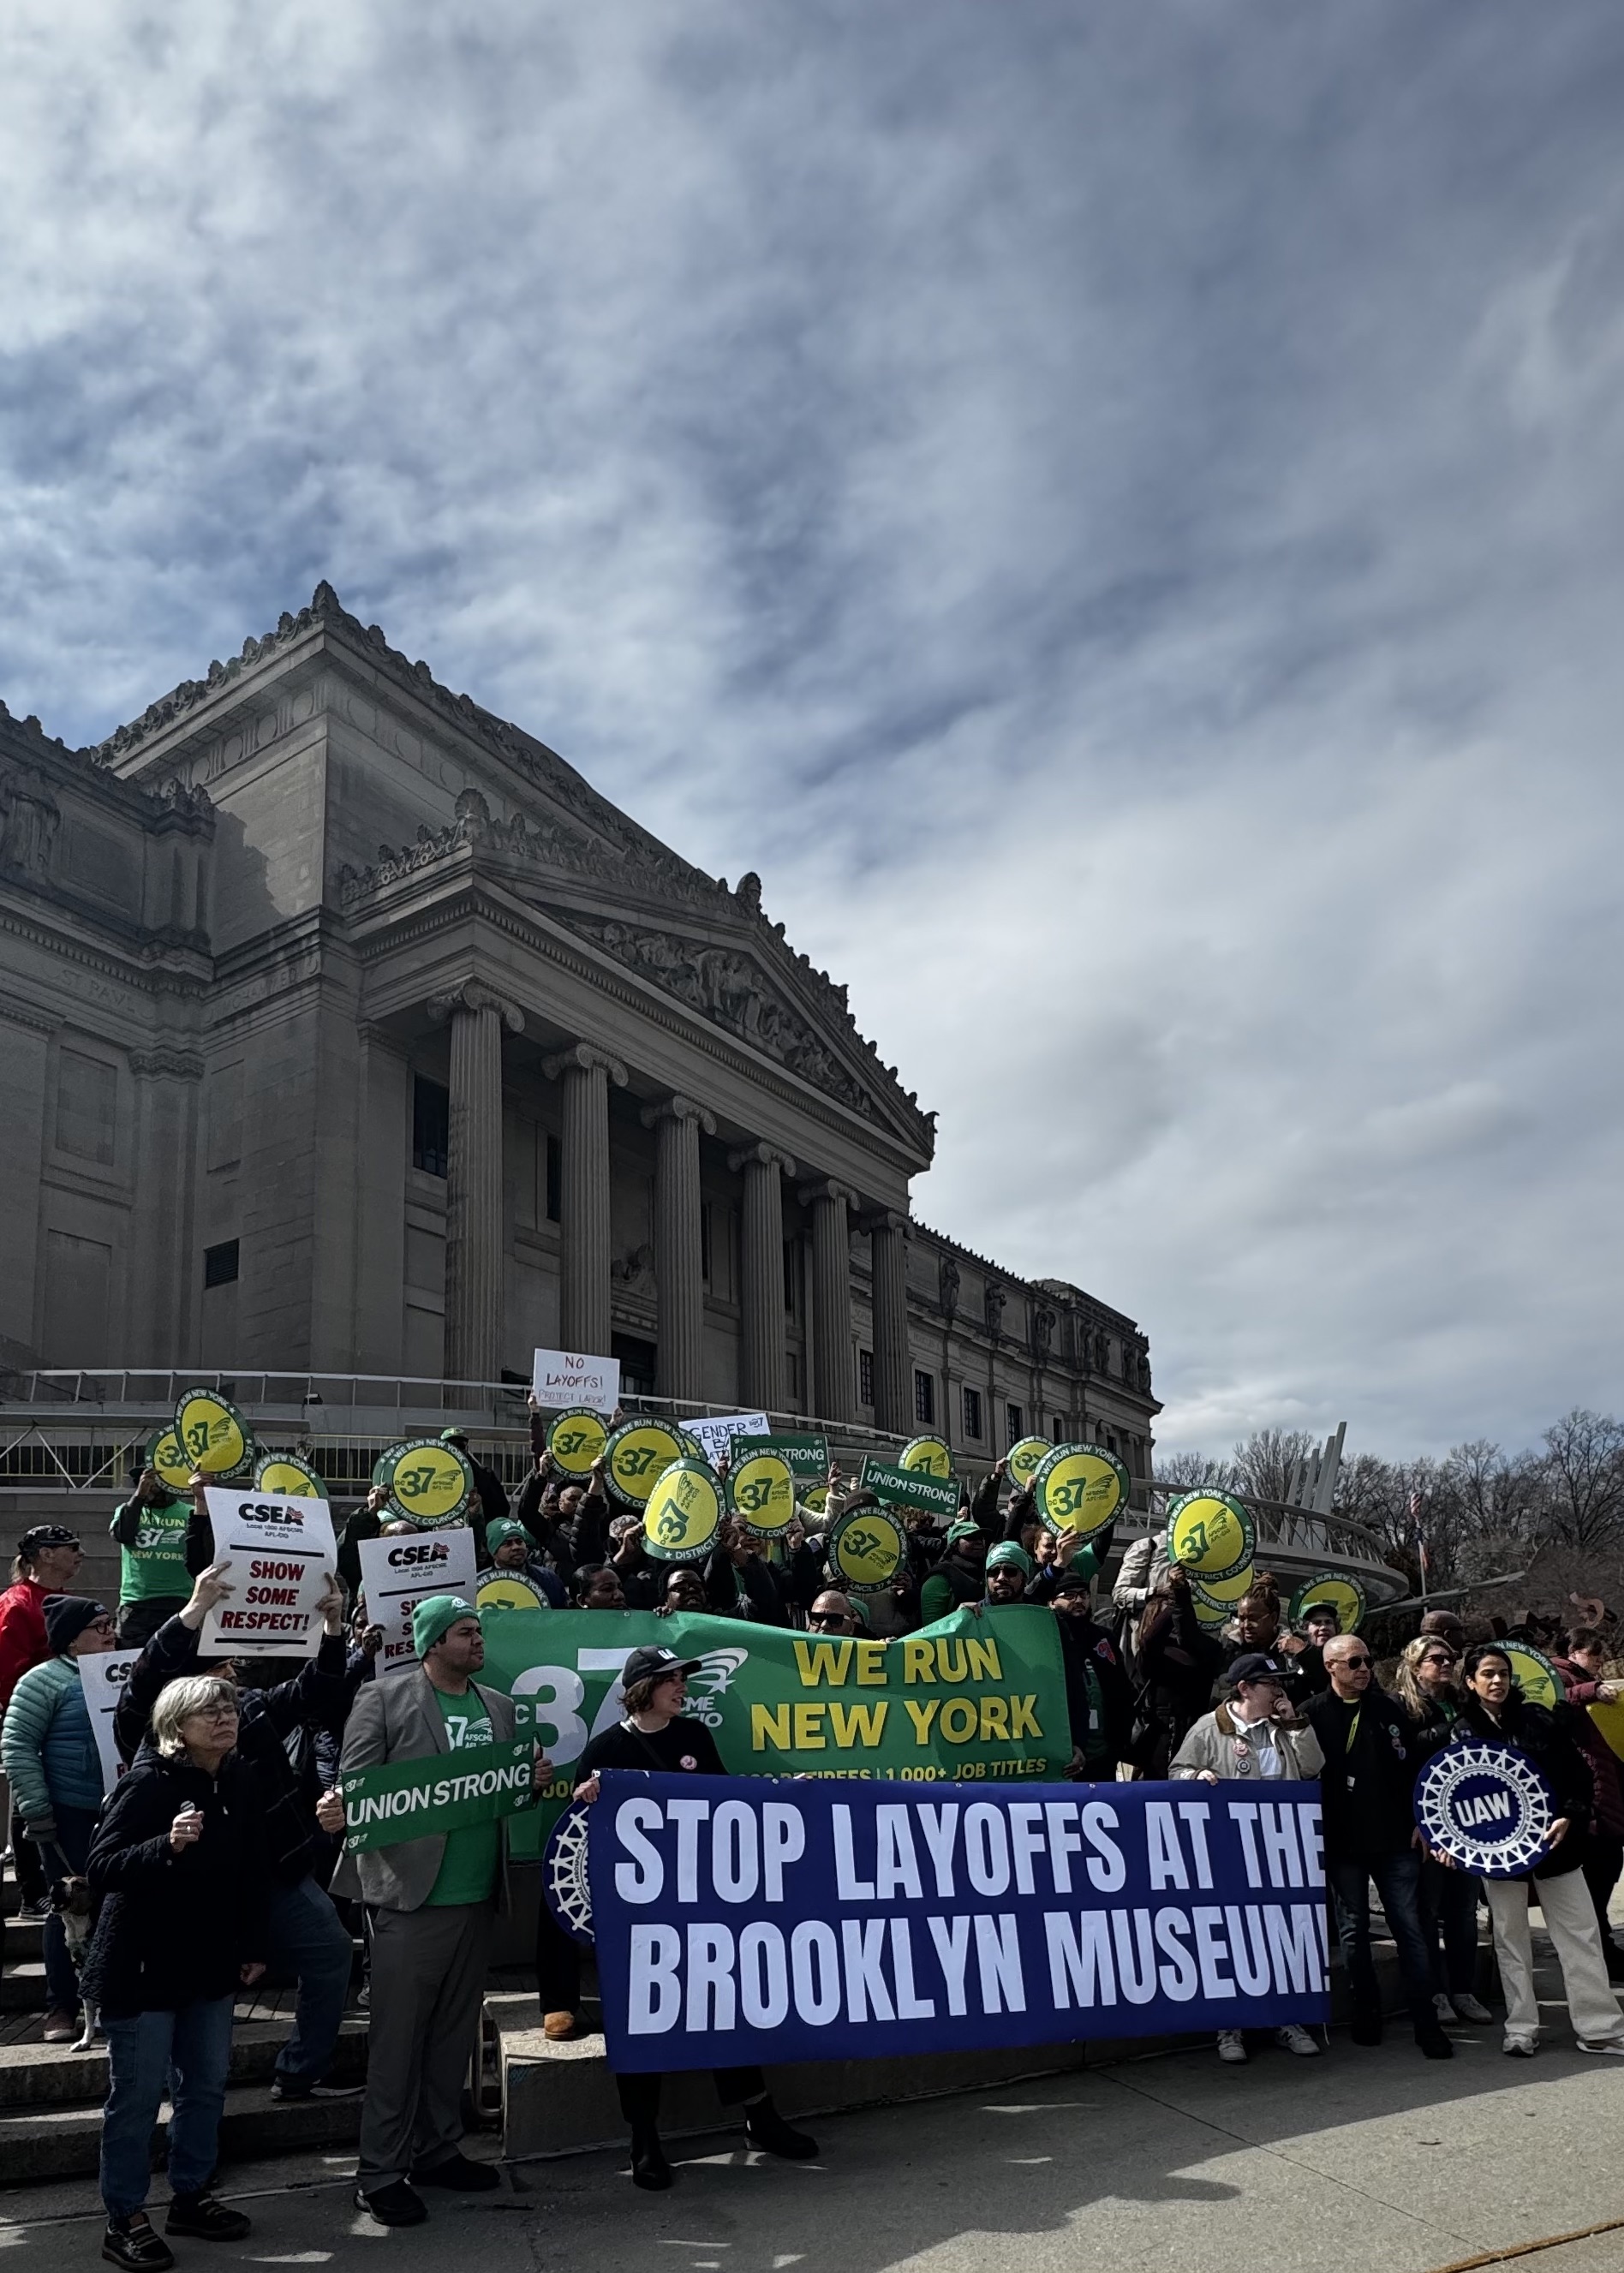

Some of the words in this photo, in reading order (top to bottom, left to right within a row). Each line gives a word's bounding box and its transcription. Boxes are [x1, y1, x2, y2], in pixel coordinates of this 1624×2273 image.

[564, 1355, 585, 1369] NO
[546, 1373, 603, 1391] LAYOFFS!
[207, 1391, 230, 1408] YORK
[188, 1422, 210, 1458] 37
[557, 1431, 588, 1456] 37
[620, 1422, 634, 1435] WE
[634, 1418, 653, 1428] RUN
[654, 1419, 672, 1431] NEW
[672, 1429, 686, 1449] YORK
[689, 1423, 749, 1441] GENDER
[272, 1454, 290, 1464] NEW
[290, 1457, 311, 1476] YORK
[393, 1447, 407, 1459] WE
[408, 1440, 424, 1448] RUN
[426, 1439, 445, 1447] NEW
[447, 1443, 466, 1462] YORK
[617, 1447, 658, 1477] 37
[730, 1460, 743, 1474] WE
[742, 1449, 758, 1464] RUN
[759, 1447, 779, 1456] NEW
[1042, 1460, 1054, 1475] WE
[1053, 1447, 1070, 1463] RUN
[1070, 1444, 1093, 1453] NEW
[1094, 1447, 1118, 1465] YORK
[400, 1466, 436, 1498] 37
[605, 1472, 632, 1505] DISTRICT
[741, 1477, 773, 1512] 37
[866, 1470, 908, 1491] UNION
[907, 1483, 957, 1505] STRONG
[1052, 1477, 1087, 1516] 37
[238, 1503, 304, 1526] CSEA
[390, 1497, 421, 1523] DISTRICT
[421, 1509, 459, 1525] COUNCIL
[658, 1498, 690, 1543] 37
[1168, 1515, 1176, 1533] WE
[1173, 1500, 1185, 1518] RUN
[1183, 1490, 1200, 1505] NEW
[1202, 1488, 1226, 1500] YORK
[135, 1527, 164, 1548] 37
[872, 1508, 888, 1518] RUN
[887, 1513, 901, 1530] NEW
[899, 1528, 907, 1551] YORK
[1078, 1517, 1114, 1542] COUNCIL
[1180, 1521, 1210, 1564] 37
[154, 1551, 185, 1560] YORK
[388, 1543, 449, 1567] CSEA
[675, 1540, 715, 1560] DISTRICT
[843, 1530, 881, 1560] 37
[249, 1560, 305, 1581] SHOW
[830, 1543, 843, 1578] DISTRICT
[1185, 1570, 1224, 1580] DISTRICT
[1226, 1544, 1254, 1576] COUNCIL
[245, 1586, 300, 1606] SOME
[477, 1575, 489, 1587] WE
[490, 1571, 507, 1580] RUN
[509, 1571, 526, 1583] NEW
[528, 1578, 545, 1600] YORK
[1196, 1589, 1227, 1610] DISTRICT
[220, 1611, 310, 1631] RESPECT!
[793, 1640, 887, 1686] WE
[904, 1638, 1003, 1684] RUN
[1506, 1642, 1526, 1651] NEW
[1529, 1647, 1551, 1668] YORK
[105, 1662, 131, 1683] CS
[751, 1701, 888, 1751] NEW
[904, 1694, 1044, 1745] YORK
[952, 1763, 986, 1781] JOB
[989, 1758, 1047, 1777] TITLES
[346, 1784, 431, 1827] UNION
[433, 1763, 530, 1806] STRONG
[1454, 1791, 1511, 1827] UAW
[615, 1798, 805, 1904] STOP
[832, 1802, 1125, 1900] LAYOFFS
[1145, 1802, 1213, 1890] AT
[1228, 1803, 1326, 1888] THE
[629, 1914, 1026, 2034] BROOKLYN
[1044, 1904, 1328, 2008] MUSEUM!
